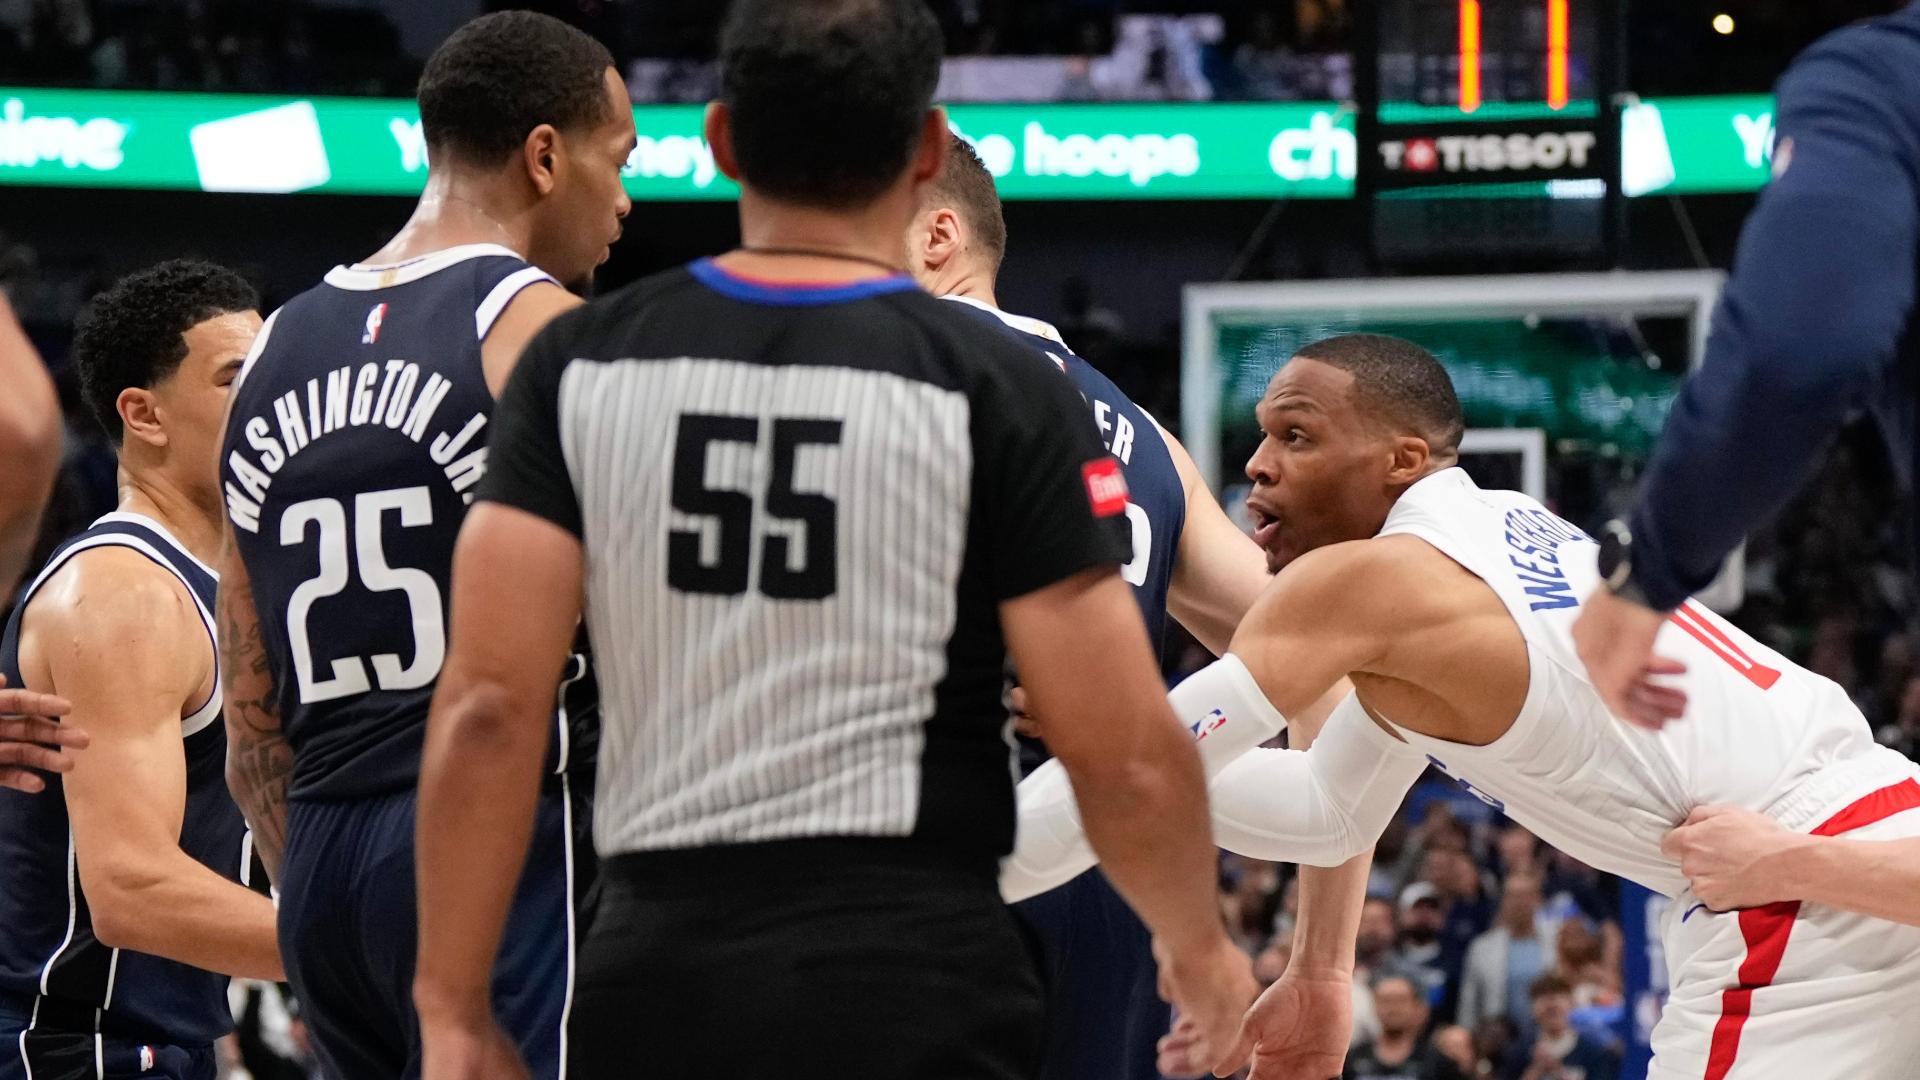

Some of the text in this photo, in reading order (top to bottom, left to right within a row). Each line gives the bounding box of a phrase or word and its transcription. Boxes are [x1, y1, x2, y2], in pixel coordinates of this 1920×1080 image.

[1024, 121, 1200, 187] hoops
[1437, 132, 1595, 172] TISSOT
[226, 360, 452, 533] WASHINGTON
[1092, 399, 1135, 466] ER
[667, 413, 845, 600] 55
[279, 485, 446, 704] 25
